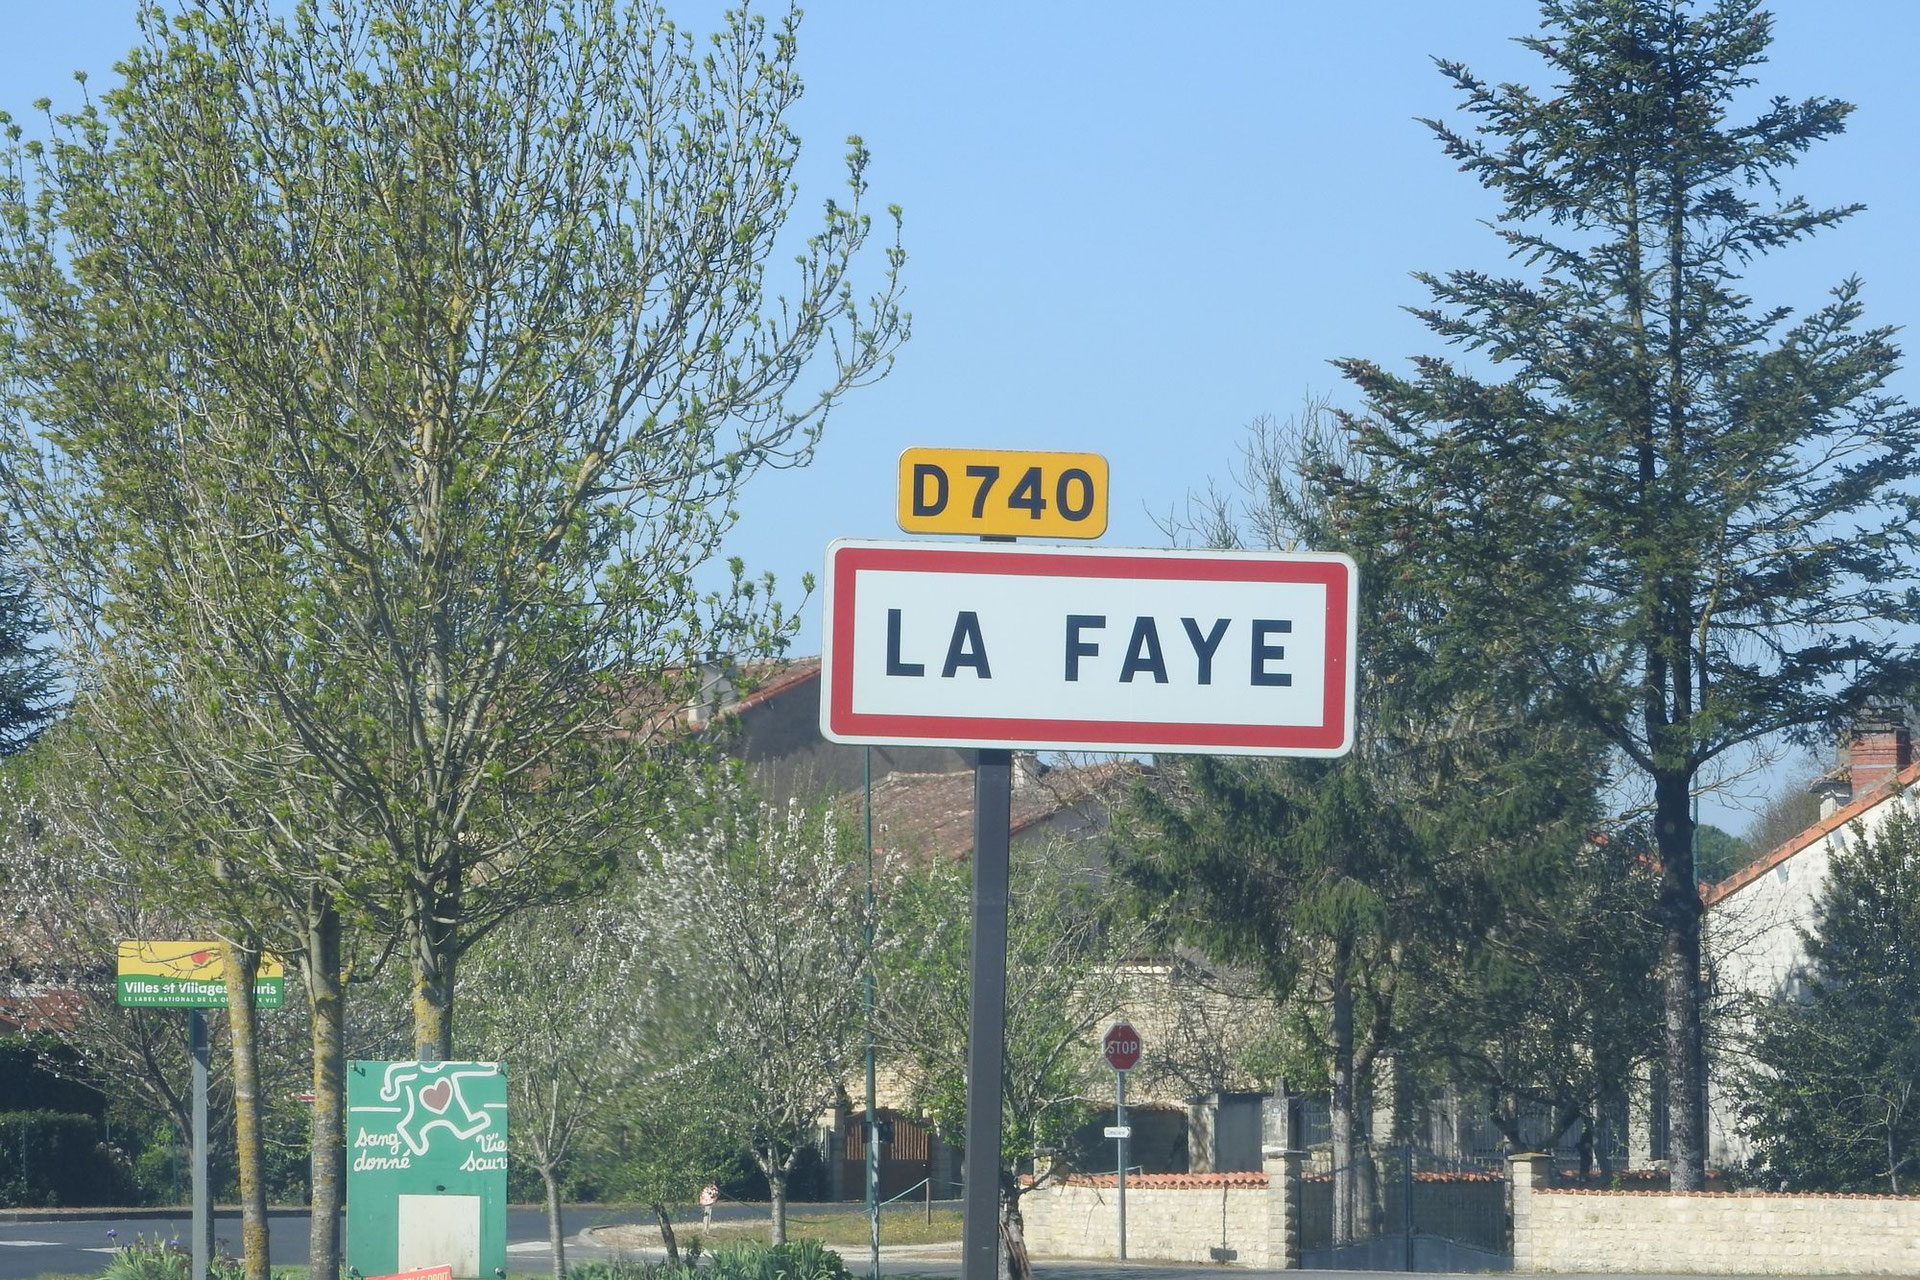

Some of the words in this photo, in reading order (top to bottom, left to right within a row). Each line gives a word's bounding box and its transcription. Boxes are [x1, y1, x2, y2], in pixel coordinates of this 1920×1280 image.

[886, 608, 993, 679] LA
[1064, 613, 1293, 687] FAYE
[124, 981, 160, 994] Villes
[162, 982, 176, 994] et
[1107, 1041, 1138, 1055] STOP
[475, 1132, 508, 1153] Vie
[353, 1148, 411, 1171] donné
